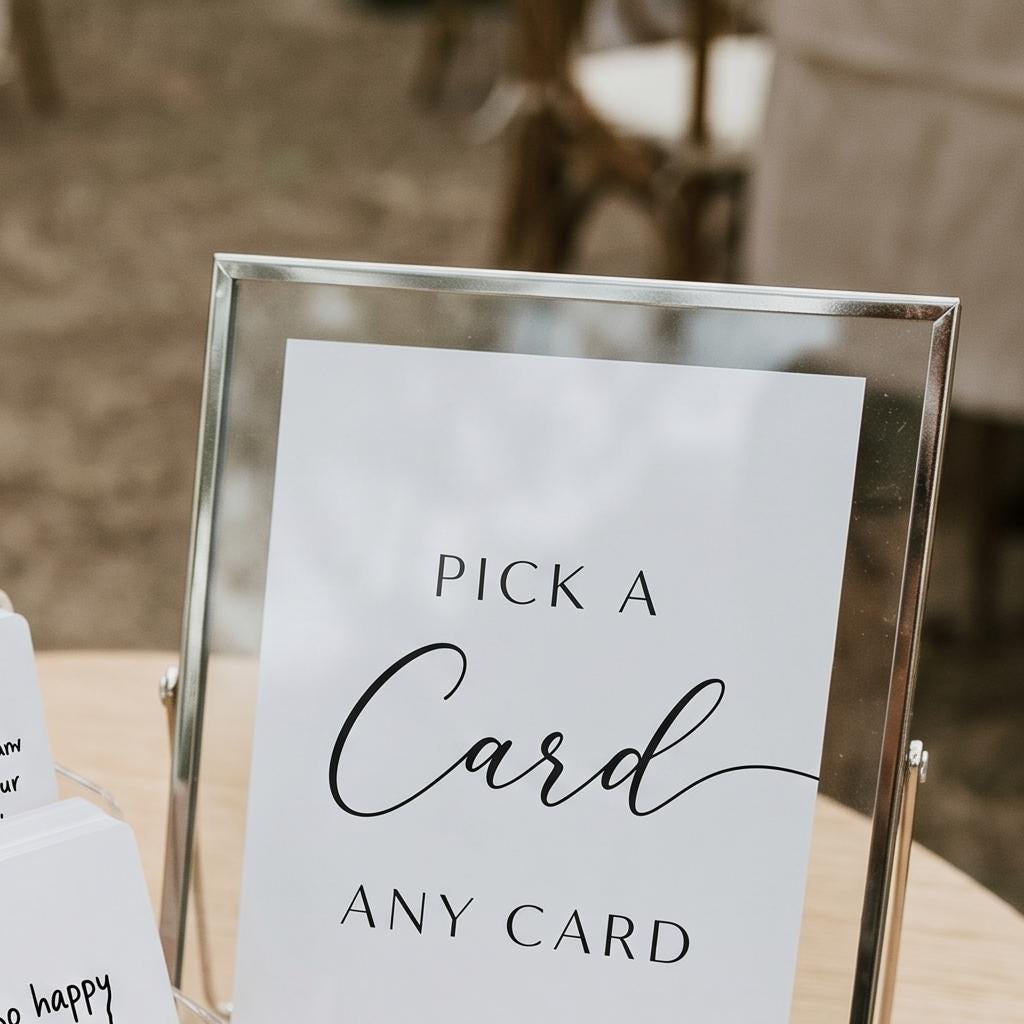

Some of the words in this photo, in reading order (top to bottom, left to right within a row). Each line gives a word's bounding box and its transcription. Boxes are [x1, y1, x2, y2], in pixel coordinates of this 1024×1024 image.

[435, 553, 585, 610] PICK
[618, 569, 657, 617] A
[328, 642, 821, 818] Card
[340, 883, 475, 938] ANY
[506, 904, 690, 964] CARD
